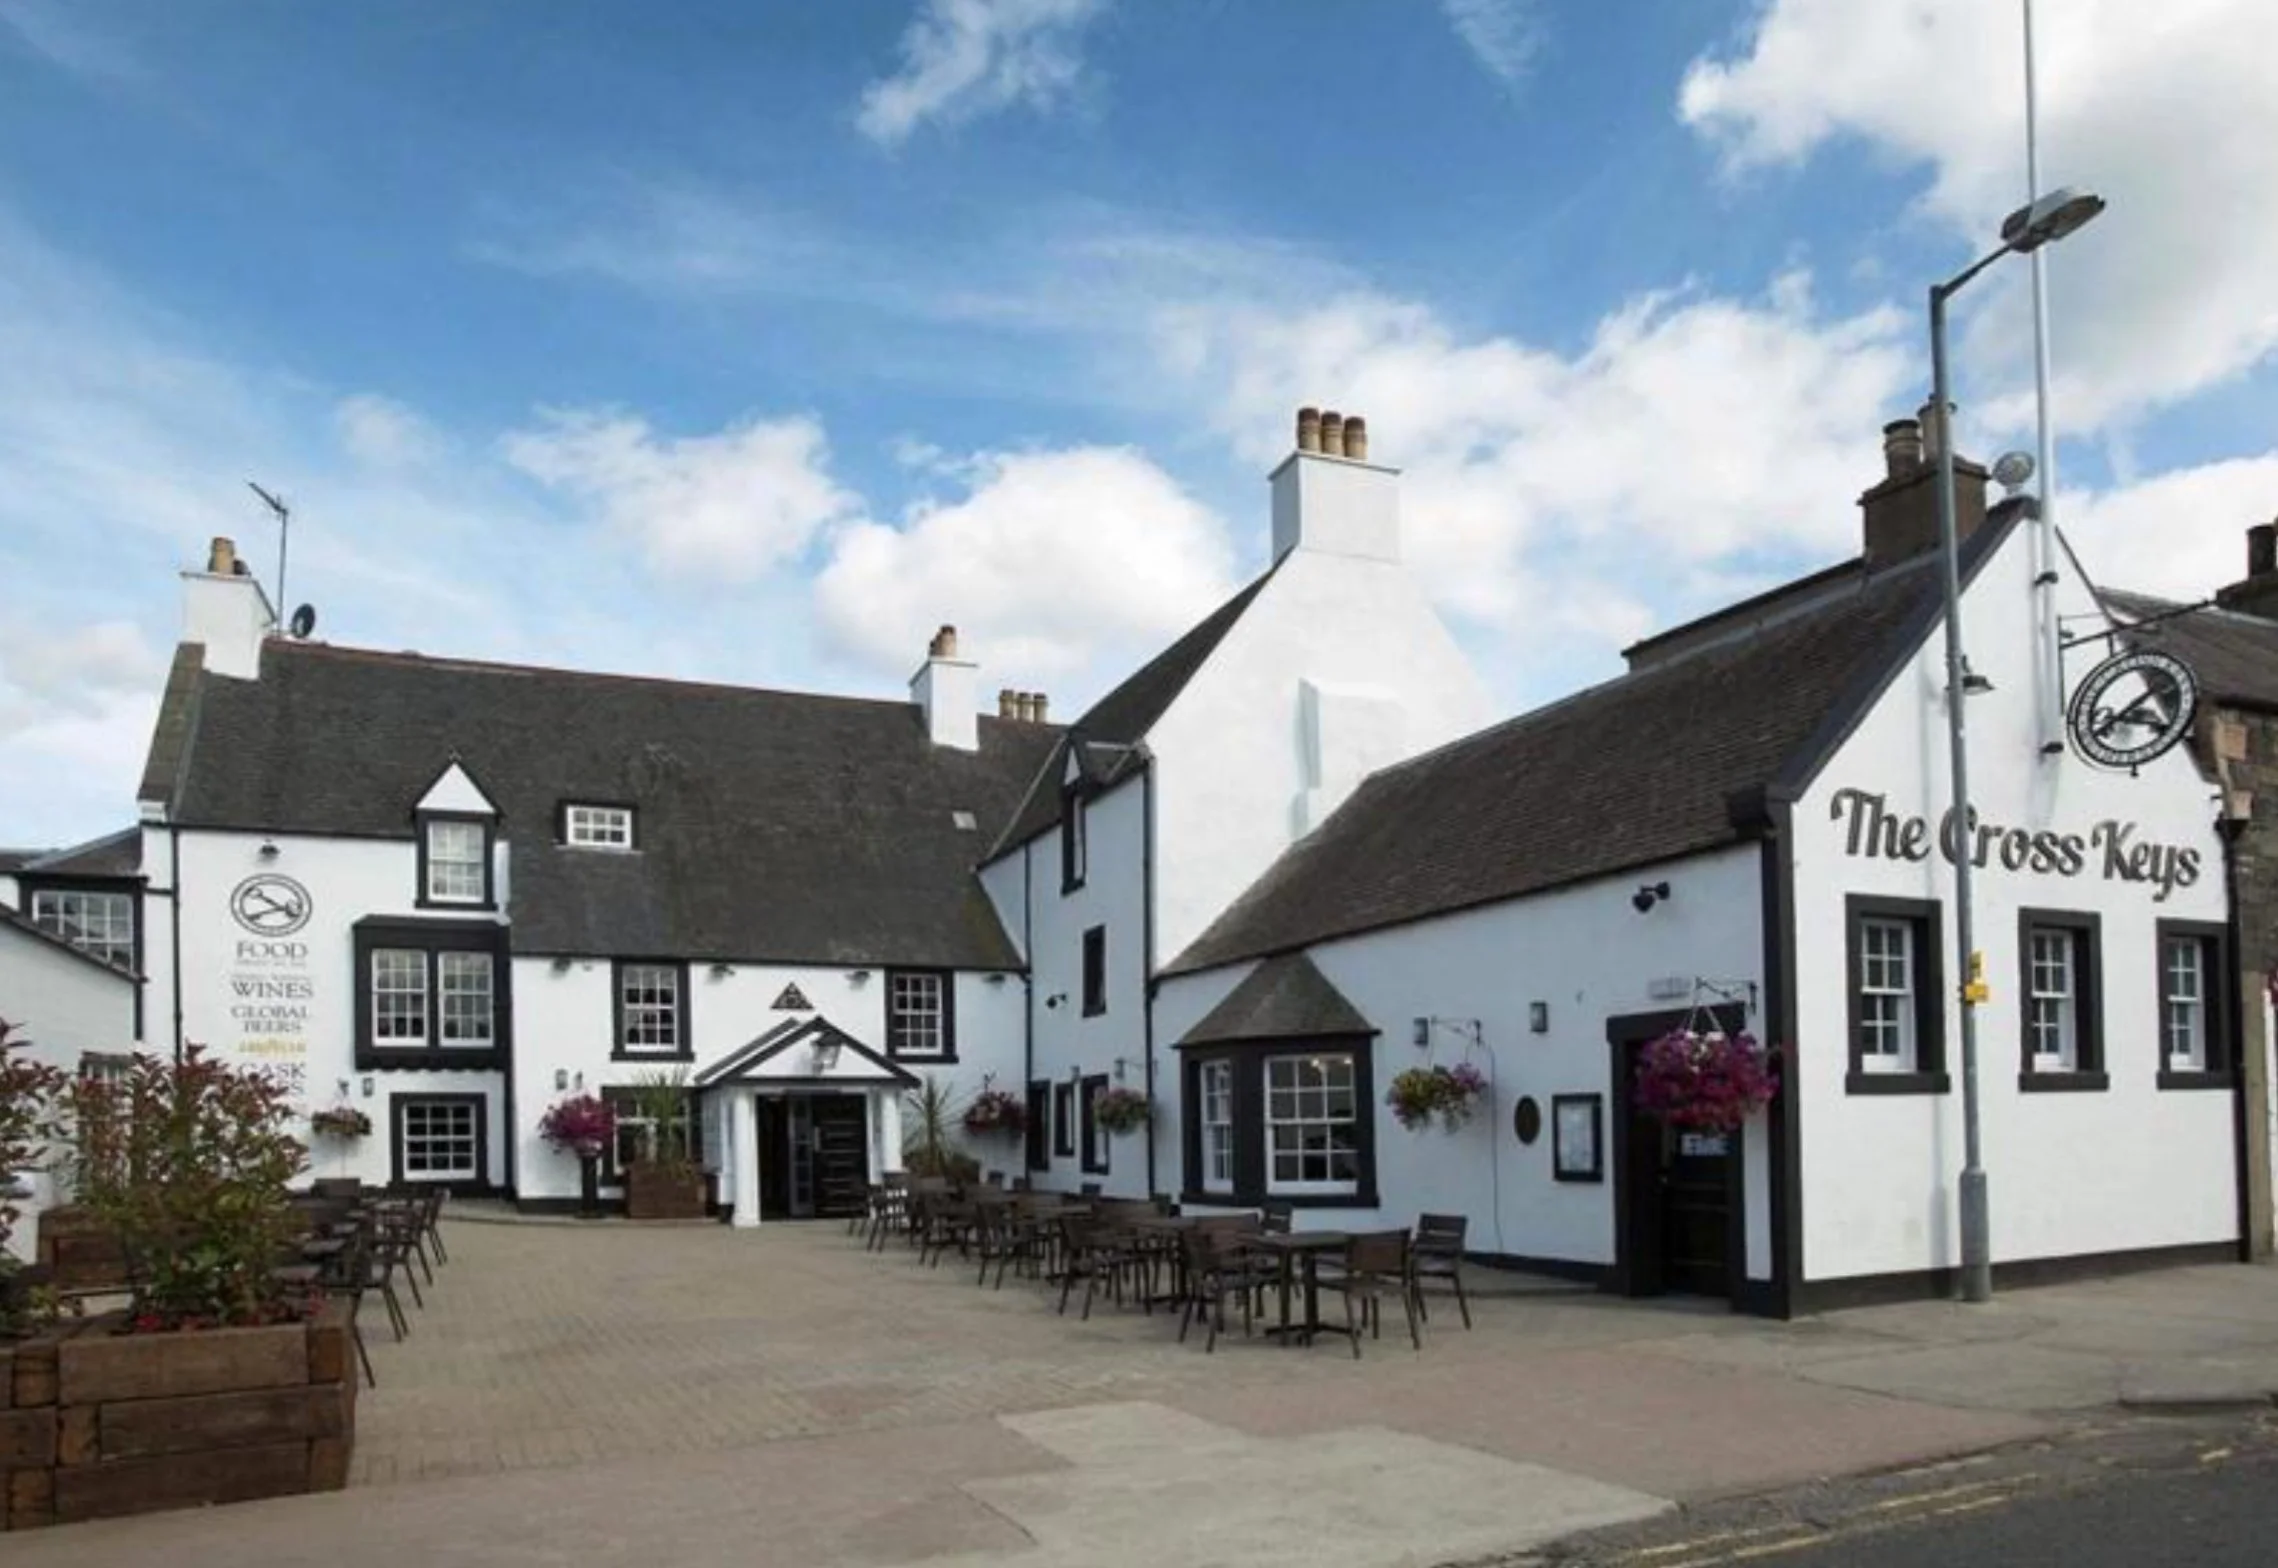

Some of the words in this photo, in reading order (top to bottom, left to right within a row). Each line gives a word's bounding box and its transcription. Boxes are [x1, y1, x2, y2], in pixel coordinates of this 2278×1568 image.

[1831, 788, 1931, 862] The
[1940, 803, 2085, 876] Cross
[2092, 820, 2201, 901] Keys
[236, 941, 308, 958] FOOD
[232, 981, 314, 998] WINES
[230, 1005, 308, 1018] GLOBAL
